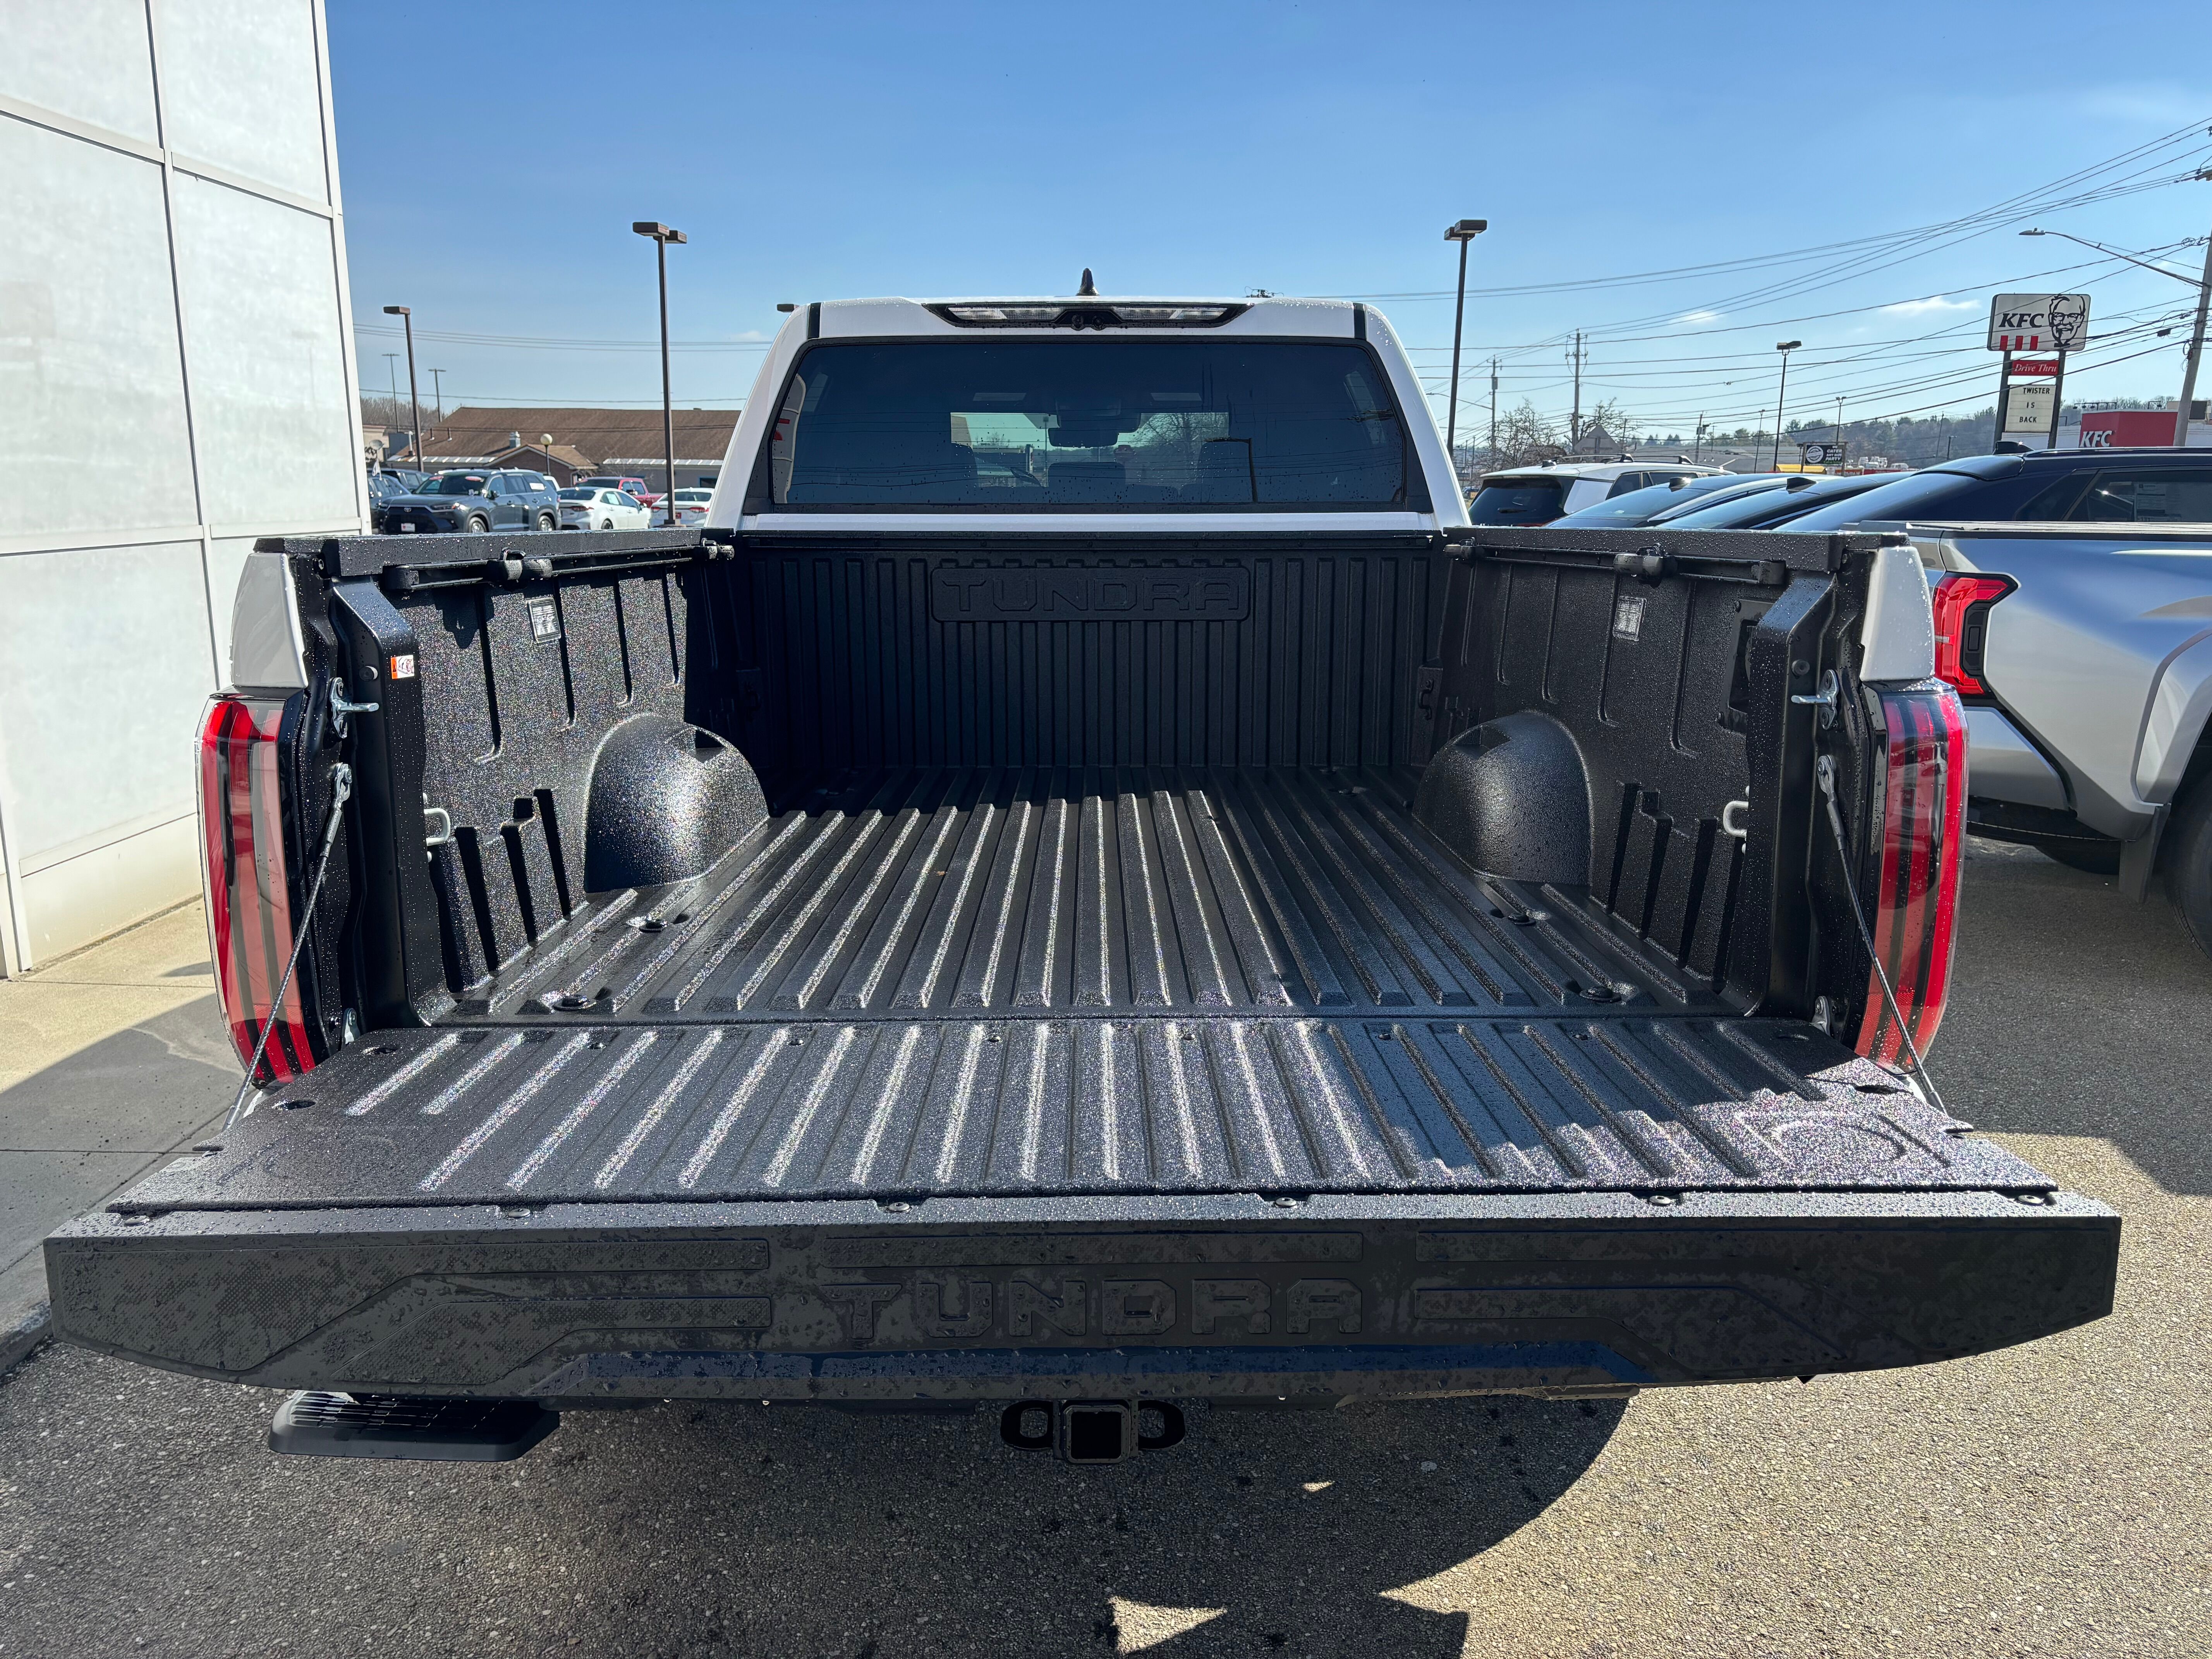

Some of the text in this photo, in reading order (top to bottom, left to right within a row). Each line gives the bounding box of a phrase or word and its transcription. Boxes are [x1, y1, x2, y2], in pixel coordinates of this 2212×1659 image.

[1998, 313, 2044, 328] KFC
[2014, 364, 2057, 372] Drive Thru
[2079, 430, 2112, 447] KFC
[941, 577, 1239, 611] TUNDRA
[818, 1278, 1363, 1340] TUNDRA
